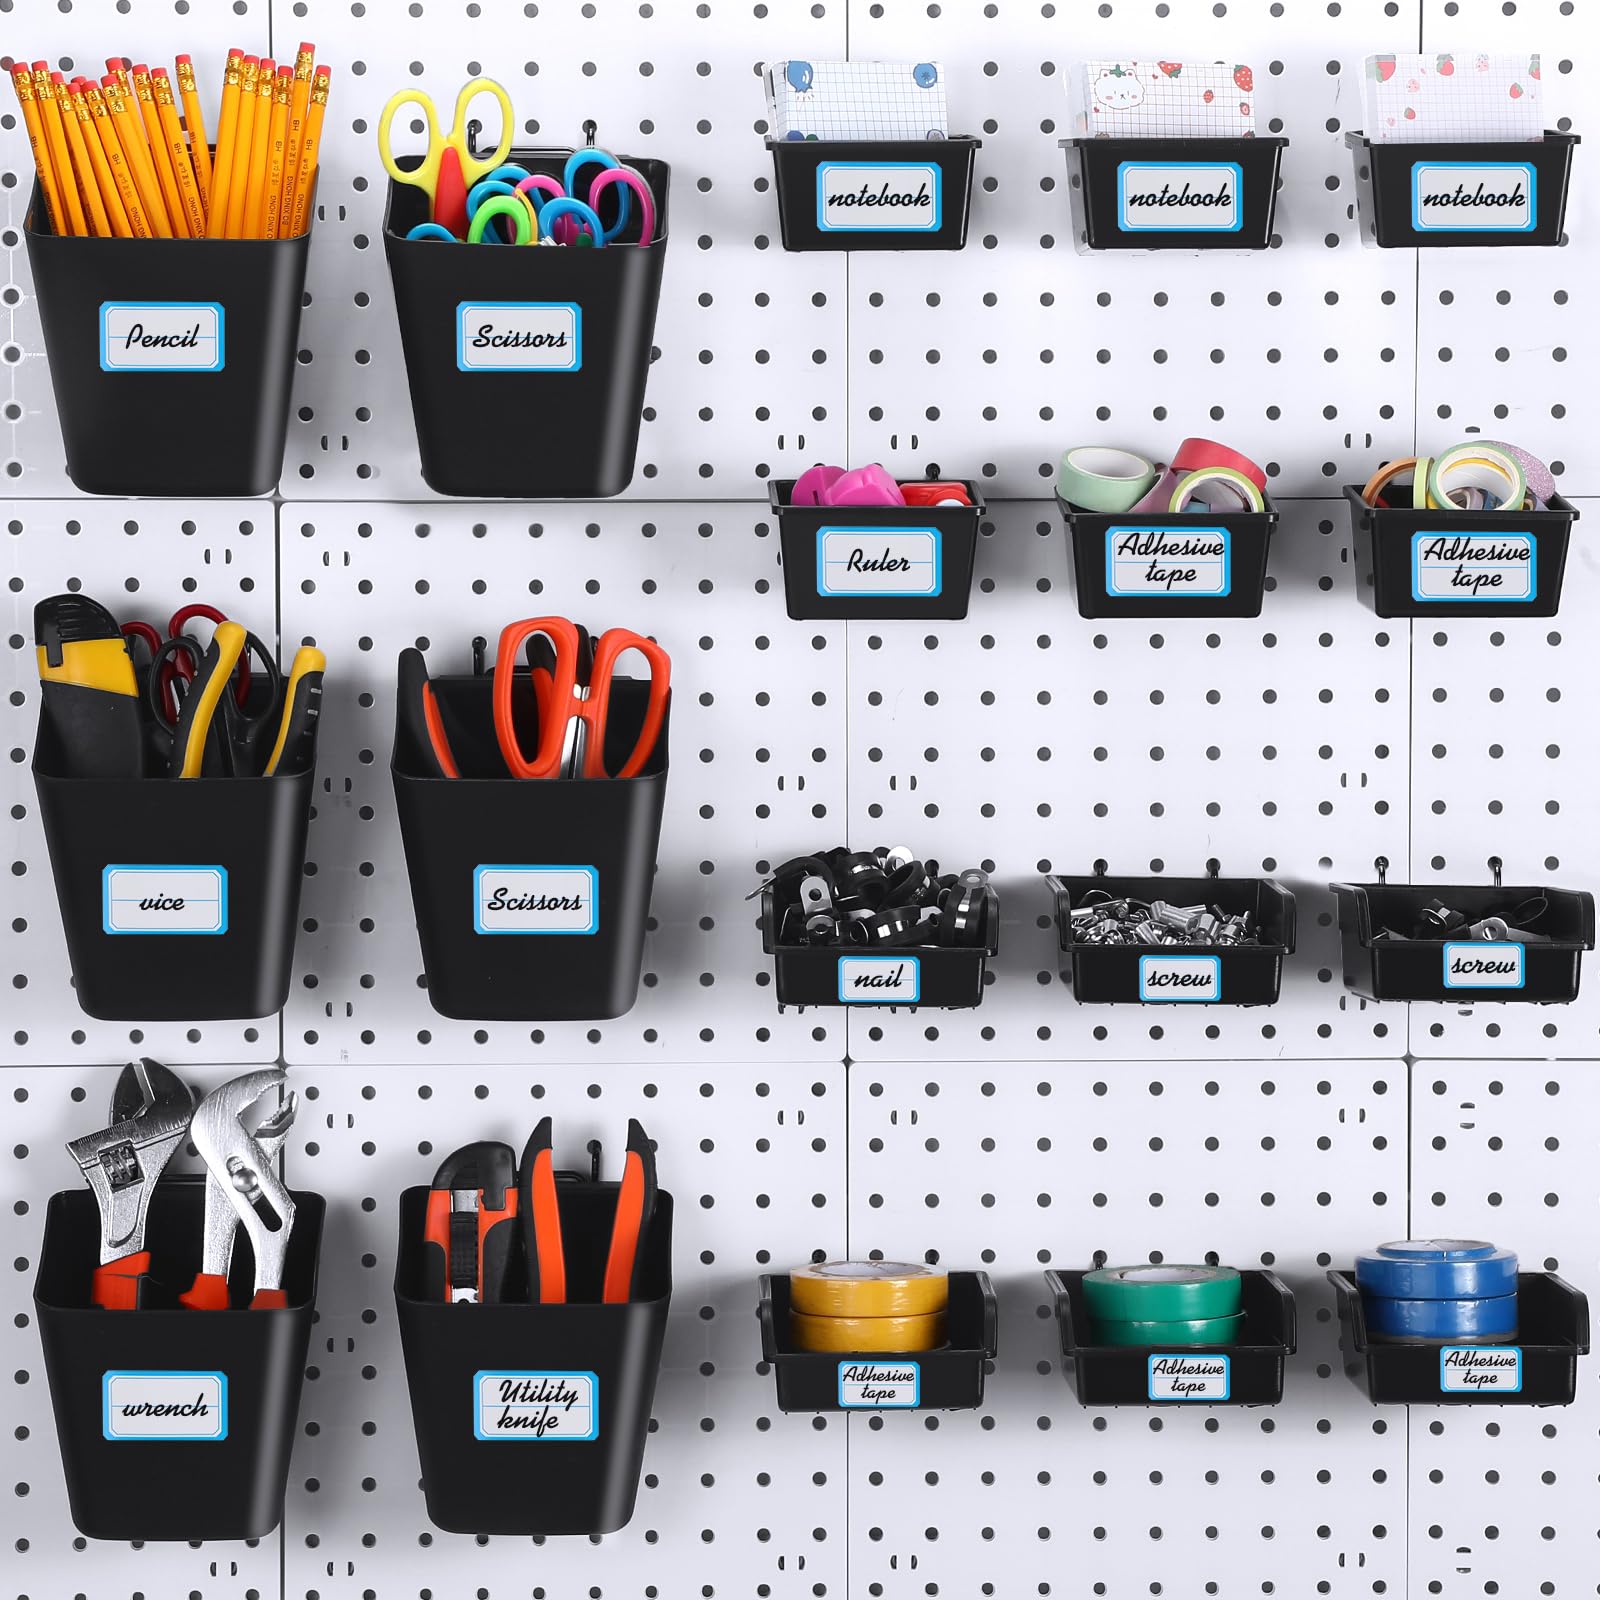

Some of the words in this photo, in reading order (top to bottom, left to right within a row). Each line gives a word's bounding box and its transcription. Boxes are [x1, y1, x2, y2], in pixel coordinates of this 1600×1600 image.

[293, 120, 299, 131] HB
[174, 143, 182, 154] HB
[276, 141, 282, 151] HB
[306, 139, 313, 150] HB
[112, 153, 120, 165] HB
[827, 182, 931, 207] notebook
[1128, 182, 1232, 207] notebook
[1422, 182, 1526, 207] notebook
[131, 206, 142, 227] HONG
[188, 197, 199, 217] HONG
[125, 323, 200, 350] Pencil
[472, 324, 568, 348] Scissors
[1117, 531, 1225, 556] Adhesive
[1423, 536, 1531, 561] Adhesive
[846, 547, 911, 573] Ruler
[1145, 560, 1197, 591] tape
[1451, 565, 1503, 596] tape
[138, 893, 185, 911] vice
[487, 887, 583, 911] Scissors
[854, 963, 904, 988] nail
[1450, 957, 1516, 974] screw
[1146, 970, 1212, 987] screw
[1153, 1358, 1225, 1375] Adhesive
[1444, 1350, 1517, 1367] Adhesive
[843, 1365, 915, 1382] Adhesive
[1464, 1369, 1499, 1389] tape
[500, 1378, 579, 1411] Utility
[861, 1384, 896, 1404] tape
[1172, 1377, 1207, 1397] tape
[121, 1392, 209, 1417] wrench
[497, 1404, 559, 1437] knife
